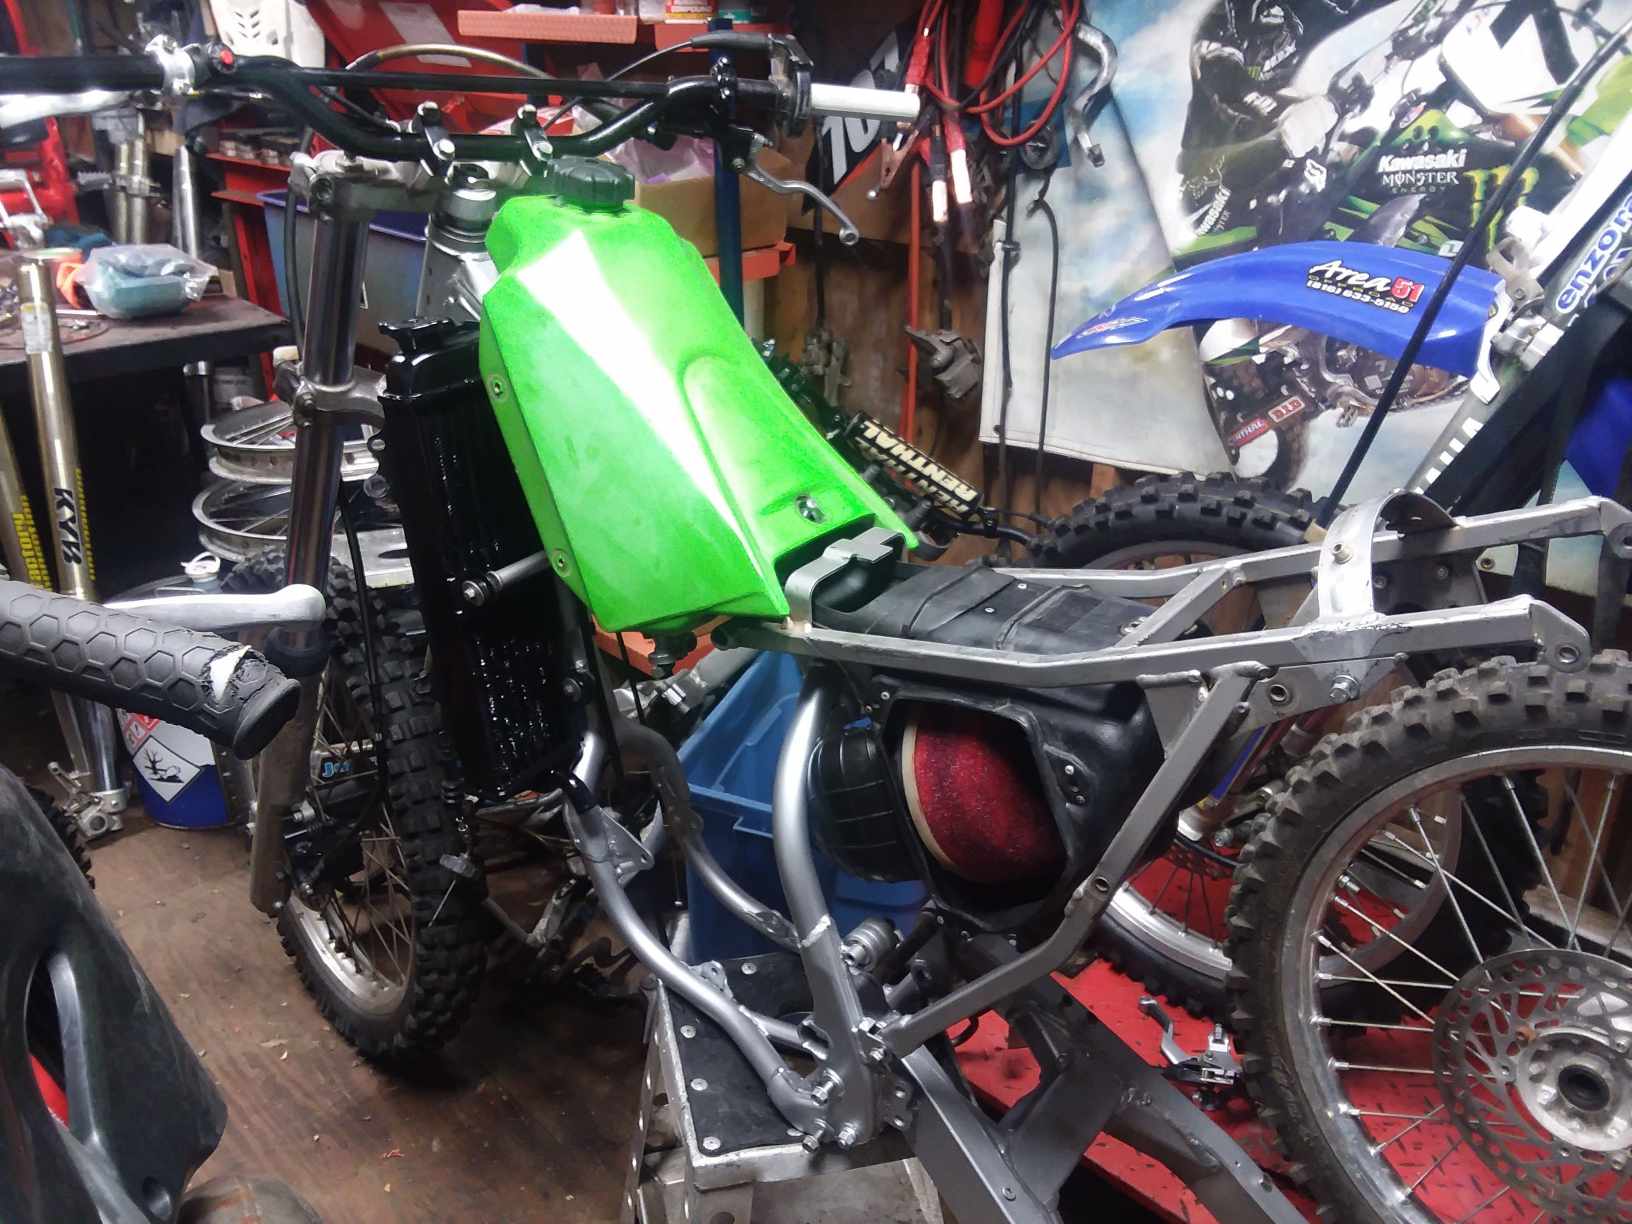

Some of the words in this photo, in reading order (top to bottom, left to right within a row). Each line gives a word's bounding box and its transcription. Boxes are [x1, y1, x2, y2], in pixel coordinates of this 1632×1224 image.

[1378, 148, 1467, 172] Kawasaki
[1382, 171, 1459, 186] MONSTER
[1308, 259, 1391, 291] Area
[1391, 276, 1425, 302] 51
[863, 420, 978, 502] RENTHAL
[54, 487, 82, 564] KYB
